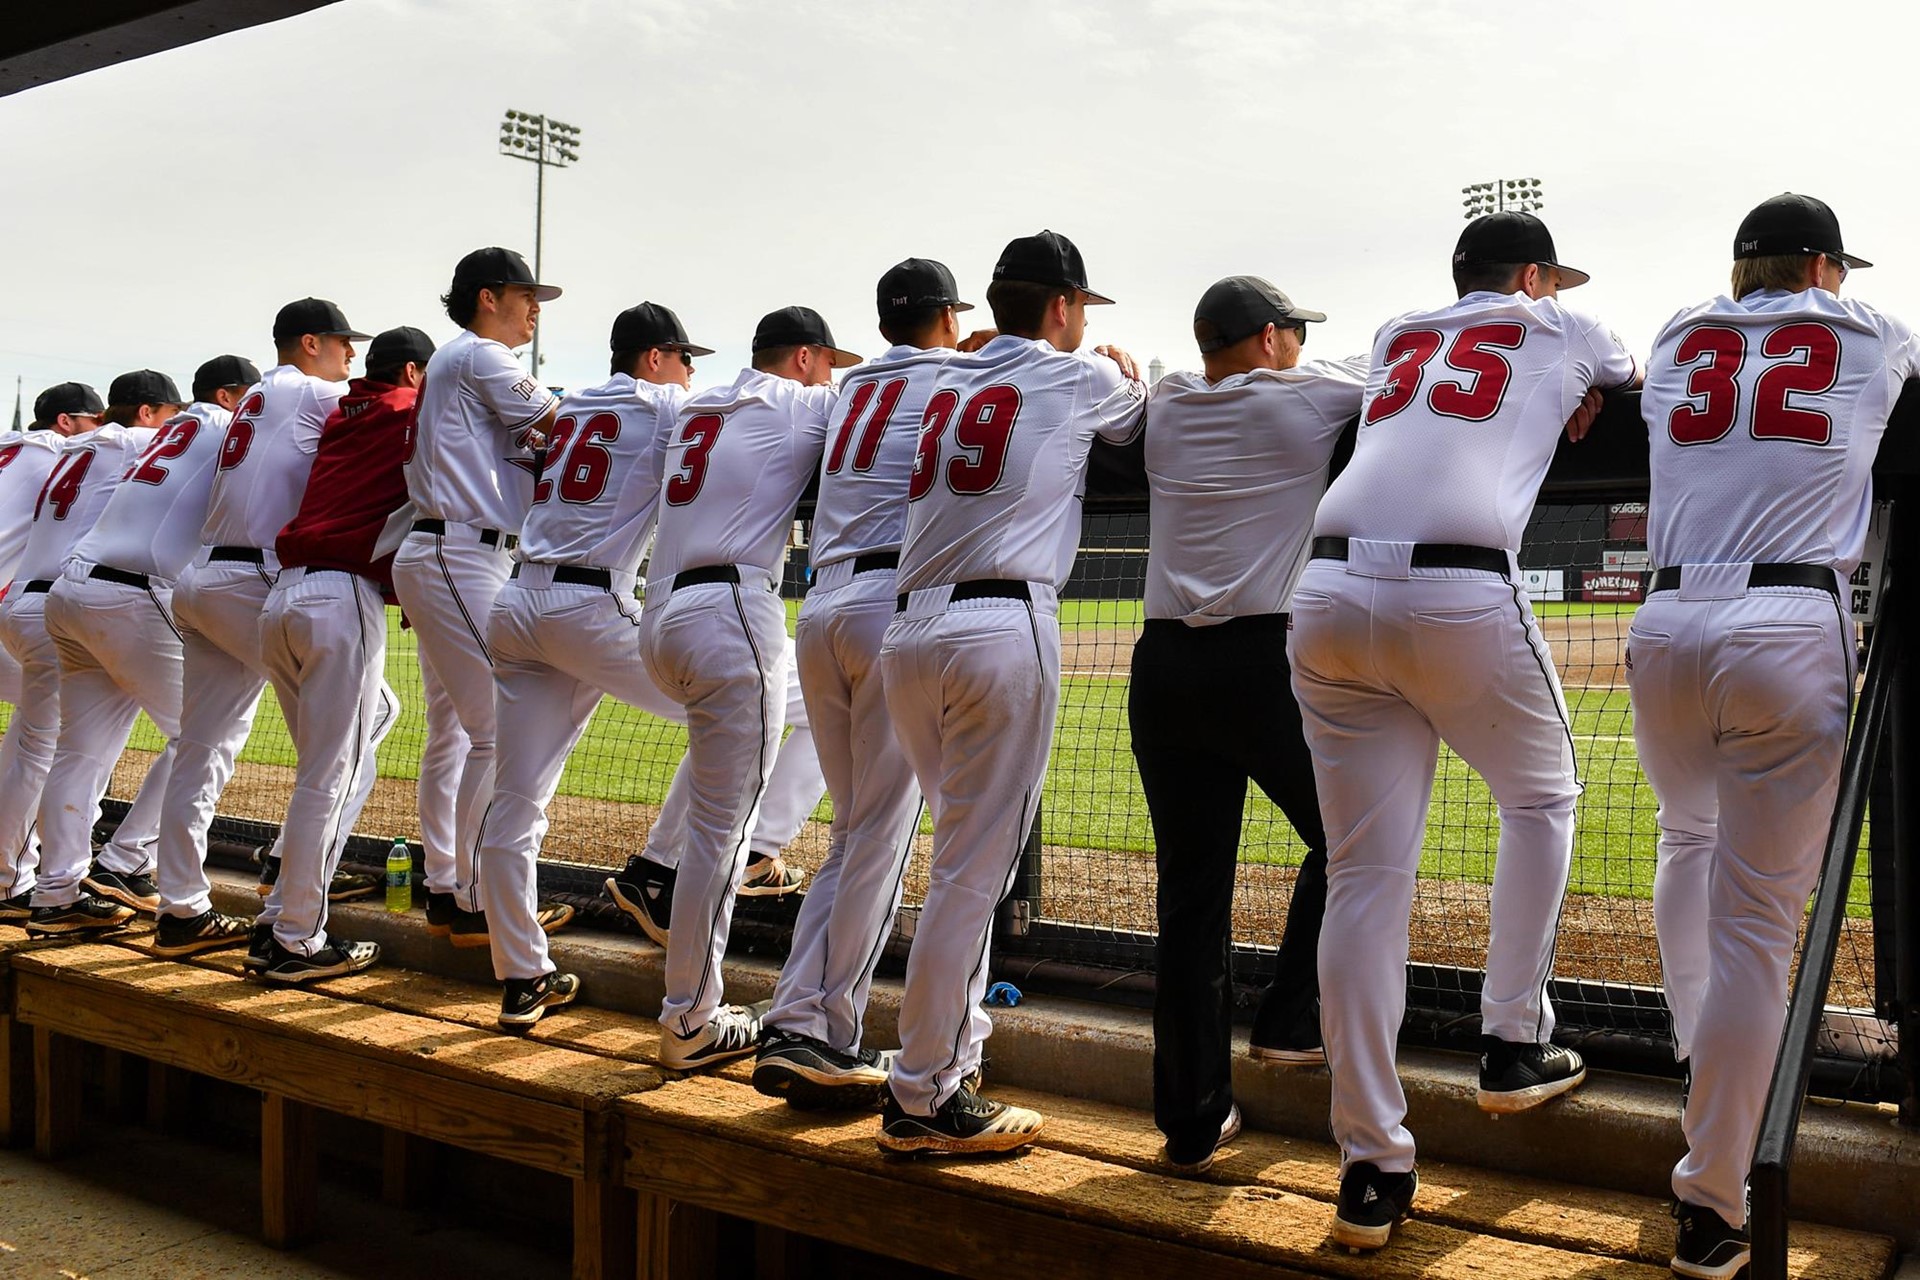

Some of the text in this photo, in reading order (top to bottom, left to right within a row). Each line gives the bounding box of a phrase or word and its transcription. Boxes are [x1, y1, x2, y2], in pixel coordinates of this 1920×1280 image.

[1365, 321, 1527, 426] 35
[1668, 321, 1842, 447] 32
[214, 391, 266, 472] 6
[533, 411, 622, 506] 26
[666, 412, 725, 507] 3
[826, 377, 908, 475] 11
[909, 382, 1022, 502] 39
[34, 449, 96, 521] 14
